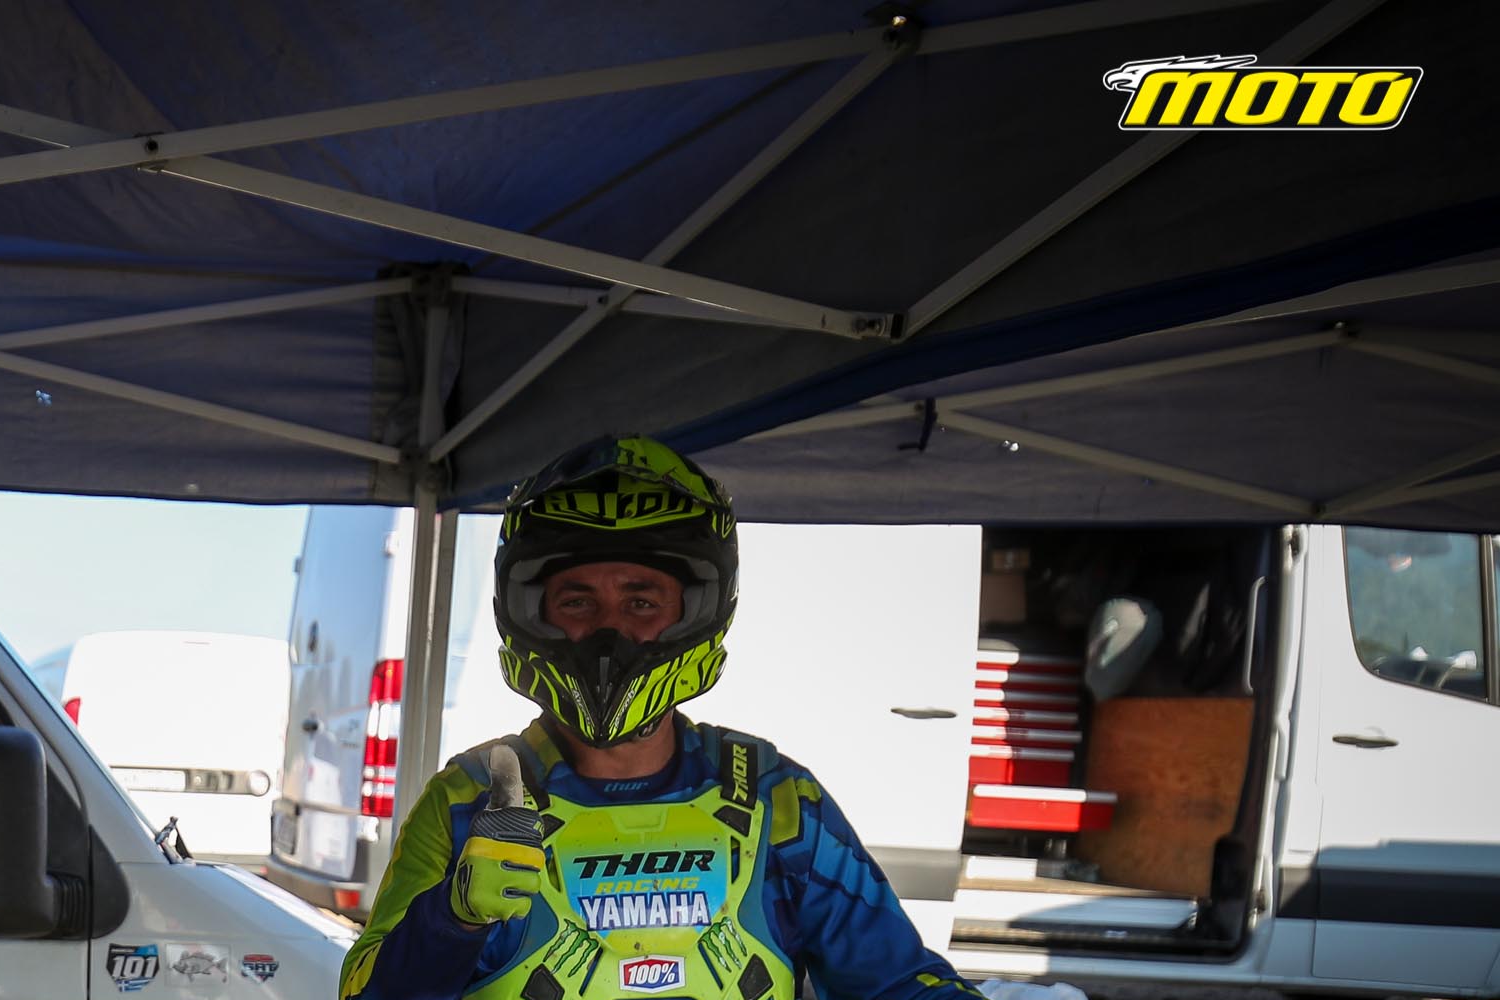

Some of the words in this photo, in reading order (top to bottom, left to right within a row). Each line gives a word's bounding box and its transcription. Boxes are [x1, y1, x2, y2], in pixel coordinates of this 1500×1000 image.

[731, 743, 748, 801] THOR
[603, 780, 649, 792] thor
[573, 849, 715, 879] THOR
[595, 876, 700, 895] RACING
[581, 893, 711, 929] YAMAHA
[111, 955, 157, 978] 101
[627, 962, 676, 986] 100%
